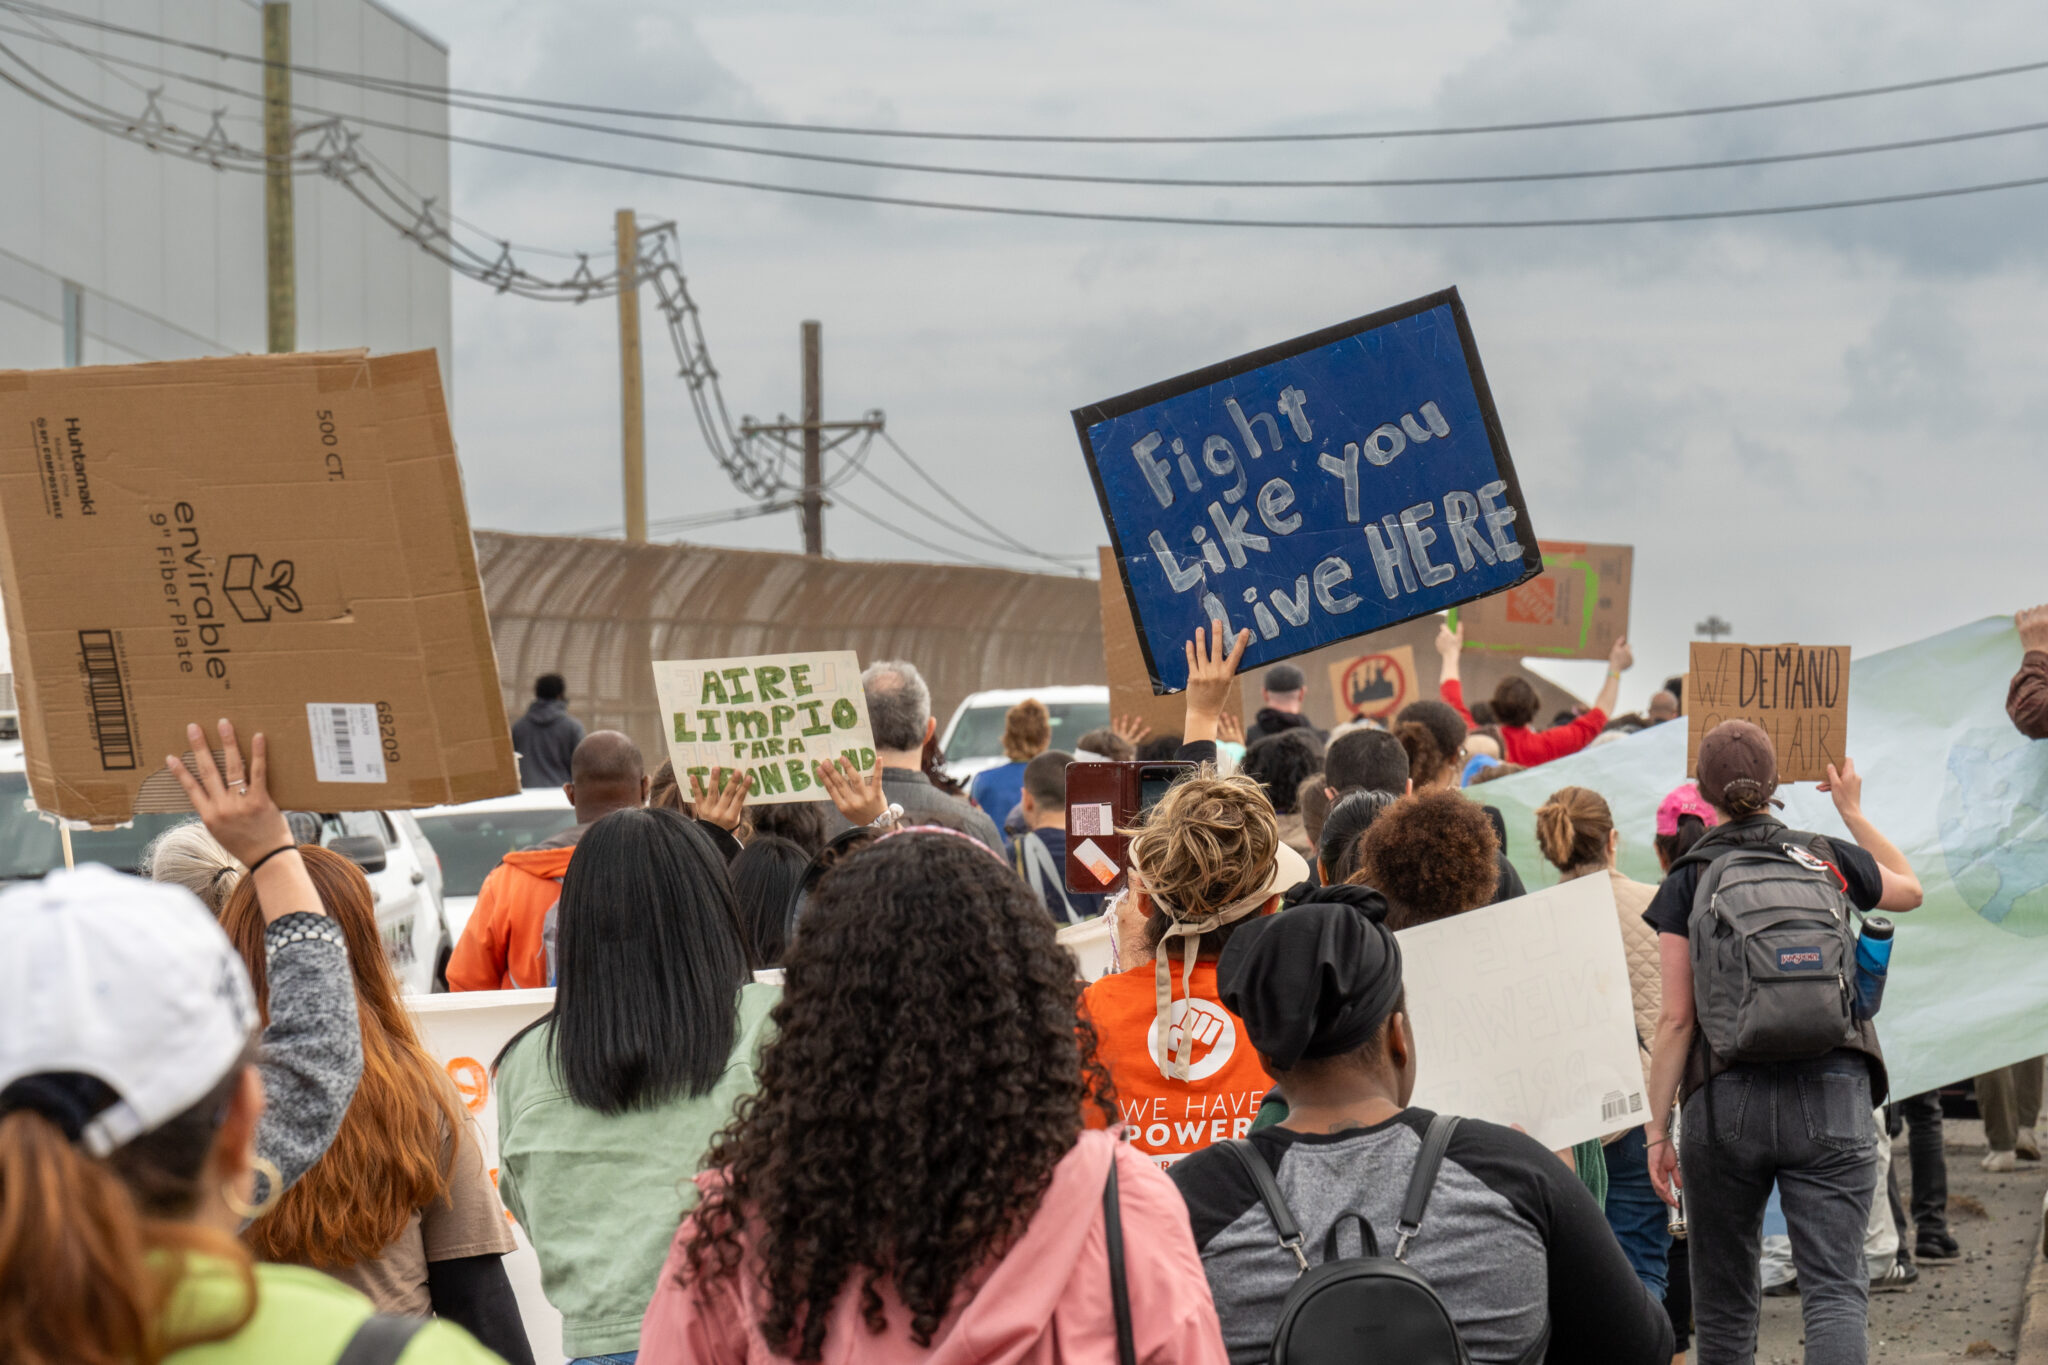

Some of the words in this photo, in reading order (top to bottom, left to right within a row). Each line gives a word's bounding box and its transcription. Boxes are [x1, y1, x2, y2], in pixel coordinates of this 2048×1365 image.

[316, 410, 338, 446] 500
[1132, 385, 1312, 509] Fight
[65, 417, 97, 515] Huhtamaki
[1148, 478, 1302, 593] Like
[174, 501, 230, 679] envirable
[1202, 555, 1362, 658] Live
[1365, 480, 1525, 599] HERE
[156, 546, 180, 607] Fiber
[170, 614, 194, 673] Plate
[701, 664, 813, 704] AIRE
[1694, 647, 1733, 708] WE
[1740, 647, 1840, 710] DEMAND
[376, 701, 400, 763] 68209
[673, 698, 858, 742] LIMPIO
[730, 737, 806, 759] PARA
[1786, 714, 1837, 772] AIR
[1120, 1097, 1168, 1121] WE
[1185, 1091, 1264, 1119] HAVE
[1126, 1117, 1252, 1147] POWER
